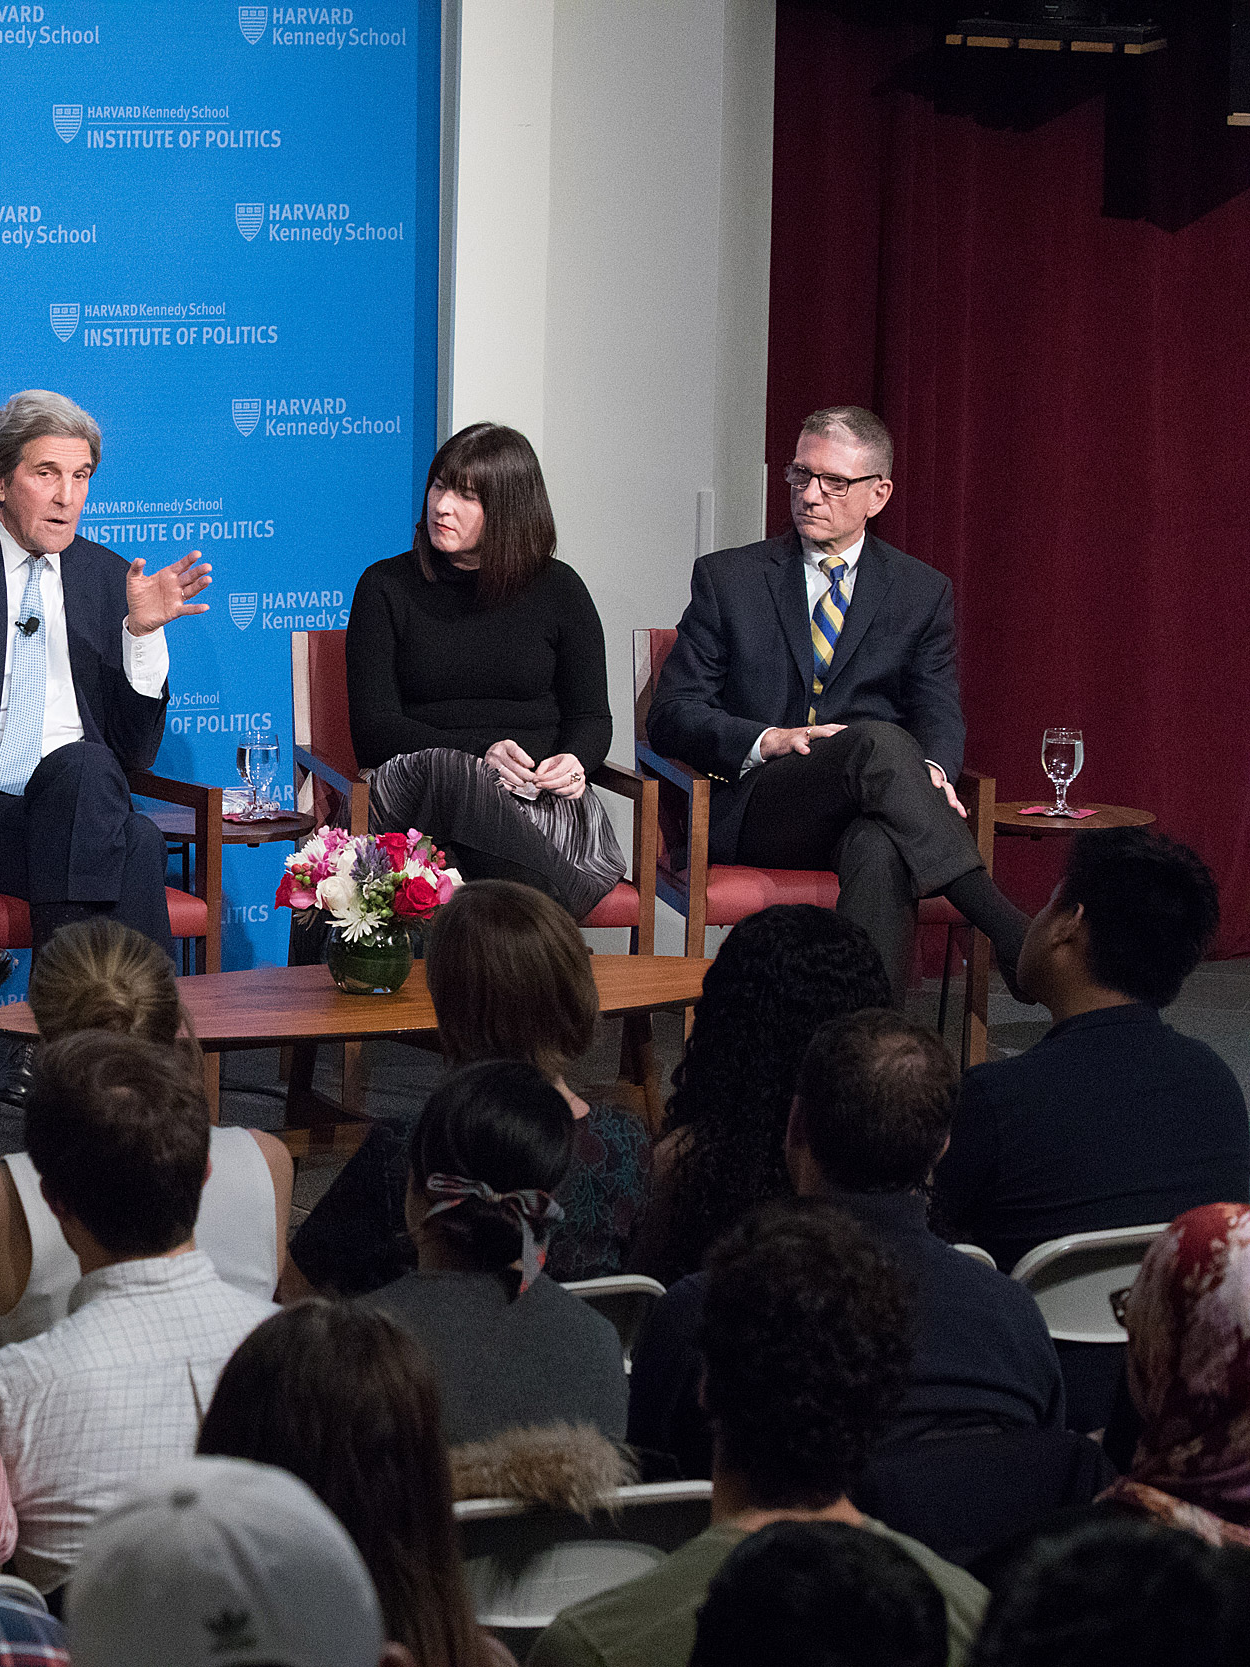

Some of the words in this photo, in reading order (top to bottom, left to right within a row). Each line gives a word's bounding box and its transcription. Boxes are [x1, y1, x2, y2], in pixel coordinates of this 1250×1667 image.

[272, 7, 354, 25] HARVARD
[38, 24, 100, 45] School
[272, 27, 347, 50] Kennedy
[348, 27, 407, 47] School
[87, 105, 141, 119] HARVARD
[141, 104, 191, 122] Kennedy
[191, 104, 230, 119] School
[86, 129, 174, 149] INSTITUTE
[178, 129, 201, 149] OF
[205, 129, 282, 149] POLITICS
[268, 203, 350, 221] HARVARD
[36, 224, 97, 244] School
[268, 222, 343, 246] Kennedy
[344, 221, 404, 241] School
[84, 303, 139, 317] HARVARD
[139, 302, 188, 319] Kennedy
[188, 301, 226, 316] School
[83, 327, 172, 347] INSTITUTE
[175, 326, 199, 346] OF
[202, 325, 278, 345] POLITICS
[265, 397, 347, 417] HARVARD
[265, 416, 340, 440] Kennedy
[341, 415, 401, 435] School
[82, 499, 136, 516] HARVARD
[136, 498, 185, 515] Kennedy
[184, 497, 223, 512] School
[81, 523, 168, 544] INSTITUTE
[172, 522, 195, 541] OF
[199, 519, 275, 541] POLITICS
[262, 590, 344, 610] HARVARD
[261, 608, 337, 631] Kennedy
[182, 691, 220, 706] School
[170, 716, 193, 734] OF
[196, 712, 272, 735] POLITICS
[221, 904, 269, 925] ITICS
